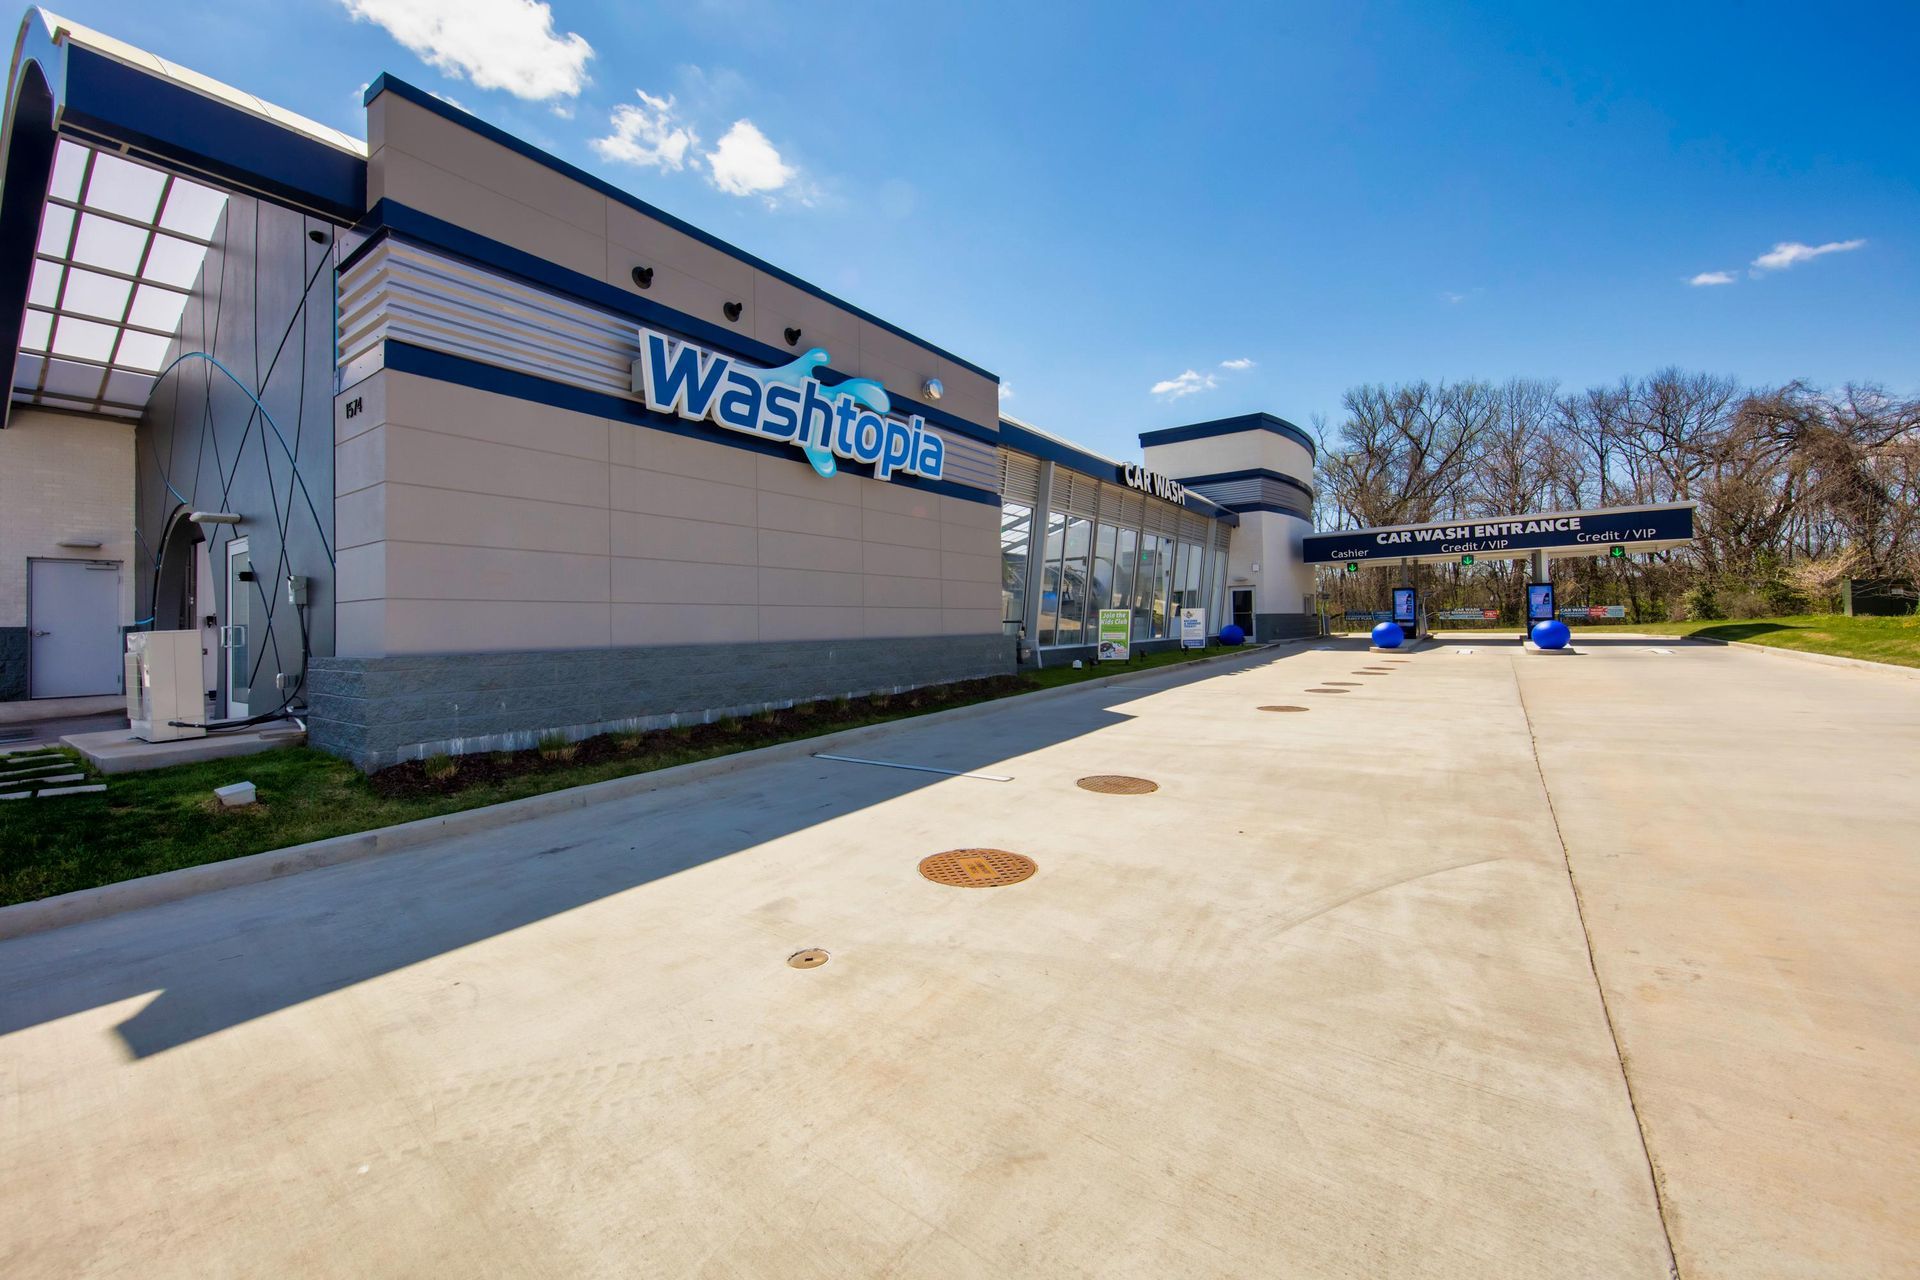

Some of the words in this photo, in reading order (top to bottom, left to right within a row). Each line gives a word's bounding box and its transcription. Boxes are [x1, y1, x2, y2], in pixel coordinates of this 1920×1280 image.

[346, 397, 362, 419] 1574
[639, 328, 945, 481] Washtopia
[1125, 462, 1152, 493] CAR
[1153, 471, 1185, 505] WASH
[1376, 531, 1412, 545] CAR
[1414, 526, 1470, 542] WASH
[1474, 517, 1581, 538] ENTRANCE
[1576, 531, 1620, 542] Credit
[1623, 529, 1630, 539] /
[1632, 528, 1657, 539] VIP
[1331, 549, 1369, 559] Cashier
[1441, 542, 1478, 553] Credit
[1480, 540, 1486, 550] /
[1488, 539, 1509, 550] VIP
